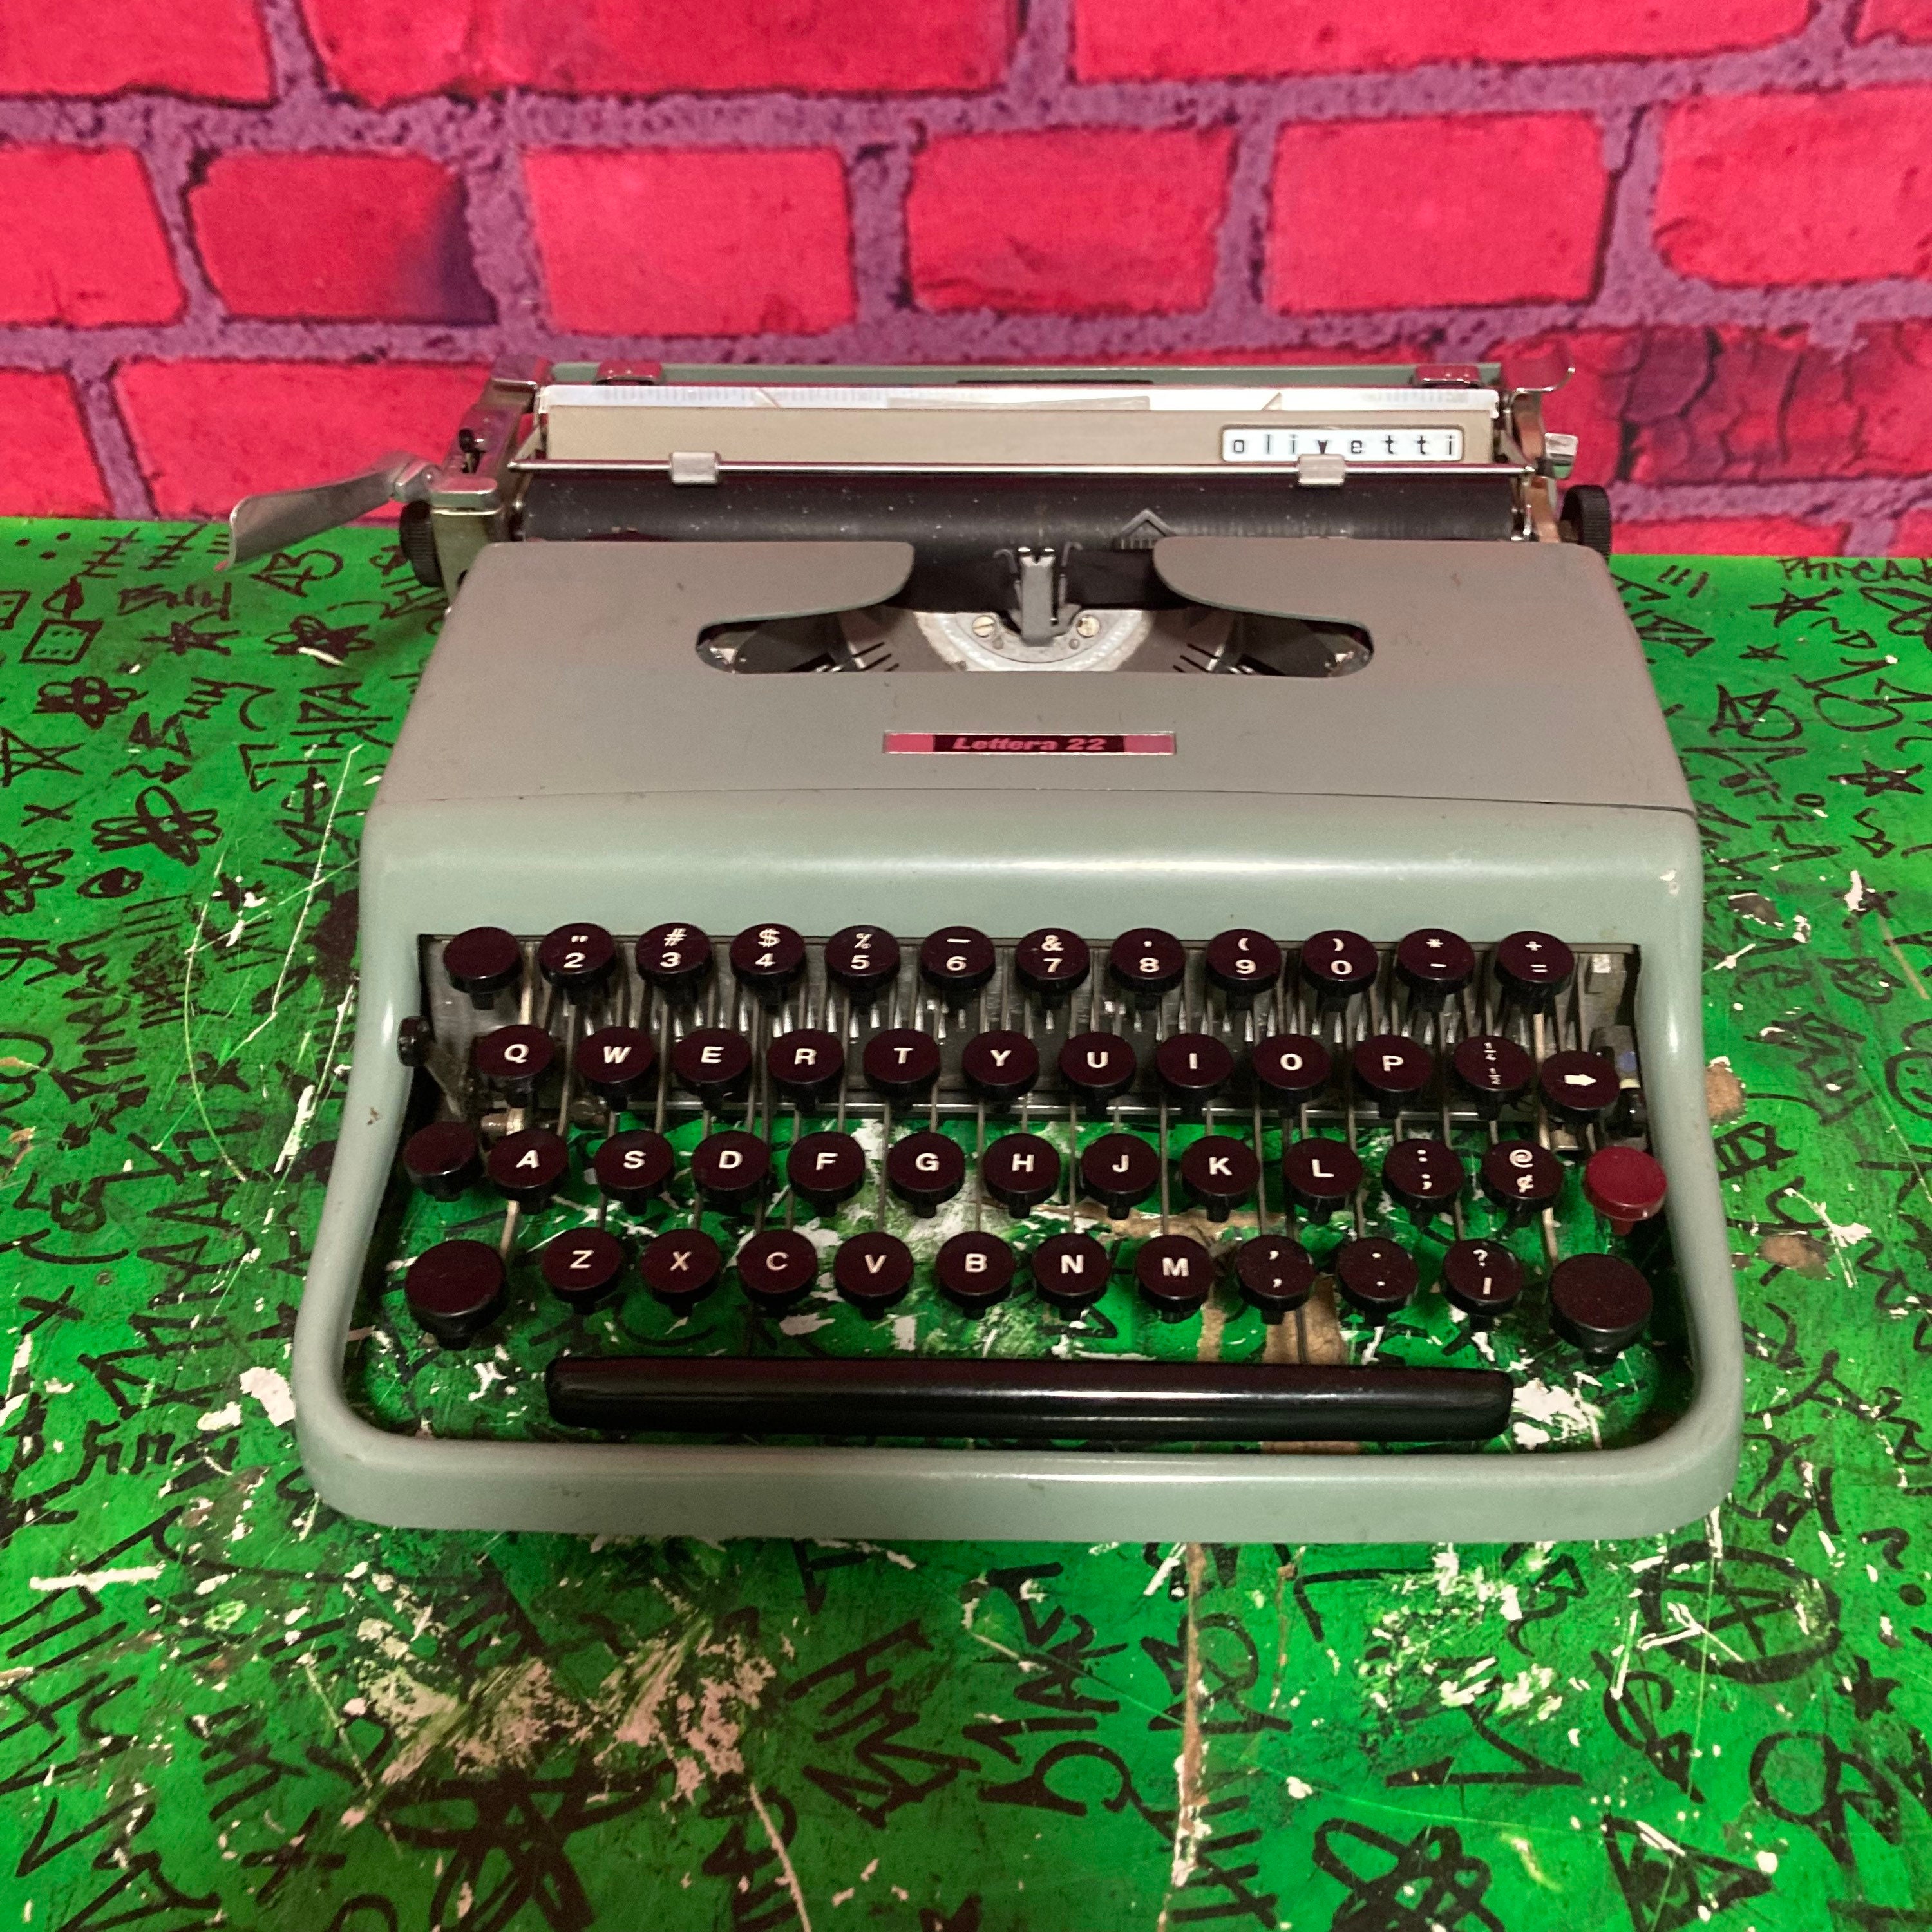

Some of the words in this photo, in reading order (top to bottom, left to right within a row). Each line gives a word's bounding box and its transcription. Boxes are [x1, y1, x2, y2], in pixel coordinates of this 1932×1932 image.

[1232, 434, 1455, 455] olivetti
[952, 736, 1058, 751] Lettera
[1065, 737, 1108, 751] 22
[663, 927, 687, 947] #
[757, 927, 781, 948] $
[853, 932, 873, 949] %
[1041, 934, 1065, 952] &
[564, 952, 585, 969] 2
[659, 952, 682, 968] 3
[755, 952, 776, 968] 4
[850, 954, 870, 970] 5
[946, 956, 967, 971] 6
[1042, 957, 1063, 974] 7
[1139, 957, 1160, 973] 8
[1235, 959, 1256, 974] 9
[504, 1043, 529, 1064] Q
[603, 1045, 632, 1065] W
[701, 1046, 724, 1064] E
[794, 1047, 817, 1065] R
[893, 1046, 913, 1065] T
[990, 1049, 1012, 1067] Y
[1086, 1051, 1109, 1069] U
[1188, 1052, 1198, 1070] I
[1279, 1053, 1303, 1071] O
[1381, 1054, 1404, 1072] P
[515, 1150, 540, 1170] A
[622, 1150, 647, 1170] S
[718, 1150, 743, 1170] D
[815, 1151, 838, 1170] F
[914, 1152, 940, 1171] G
[1011, 1153, 1034, 1173] H
[1111, 1155, 1129, 1173] J
[1208, 1156, 1233, 1176] K
[1508, 1149, 1534, 1168] @
[1311, 1159, 1335, 1179] L
[569, 1249, 594, 1269] Z
[669, 1251, 692, 1271] X
[765, 1251, 789, 1271] C
[864, 1254, 887, 1274] V
[964, 1253, 987, 1273] B
[1060, 1254, 1084, 1274] N
[1472, 1248, 1489, 1267] ?
[1161, 1257, 1189, 1278] M
